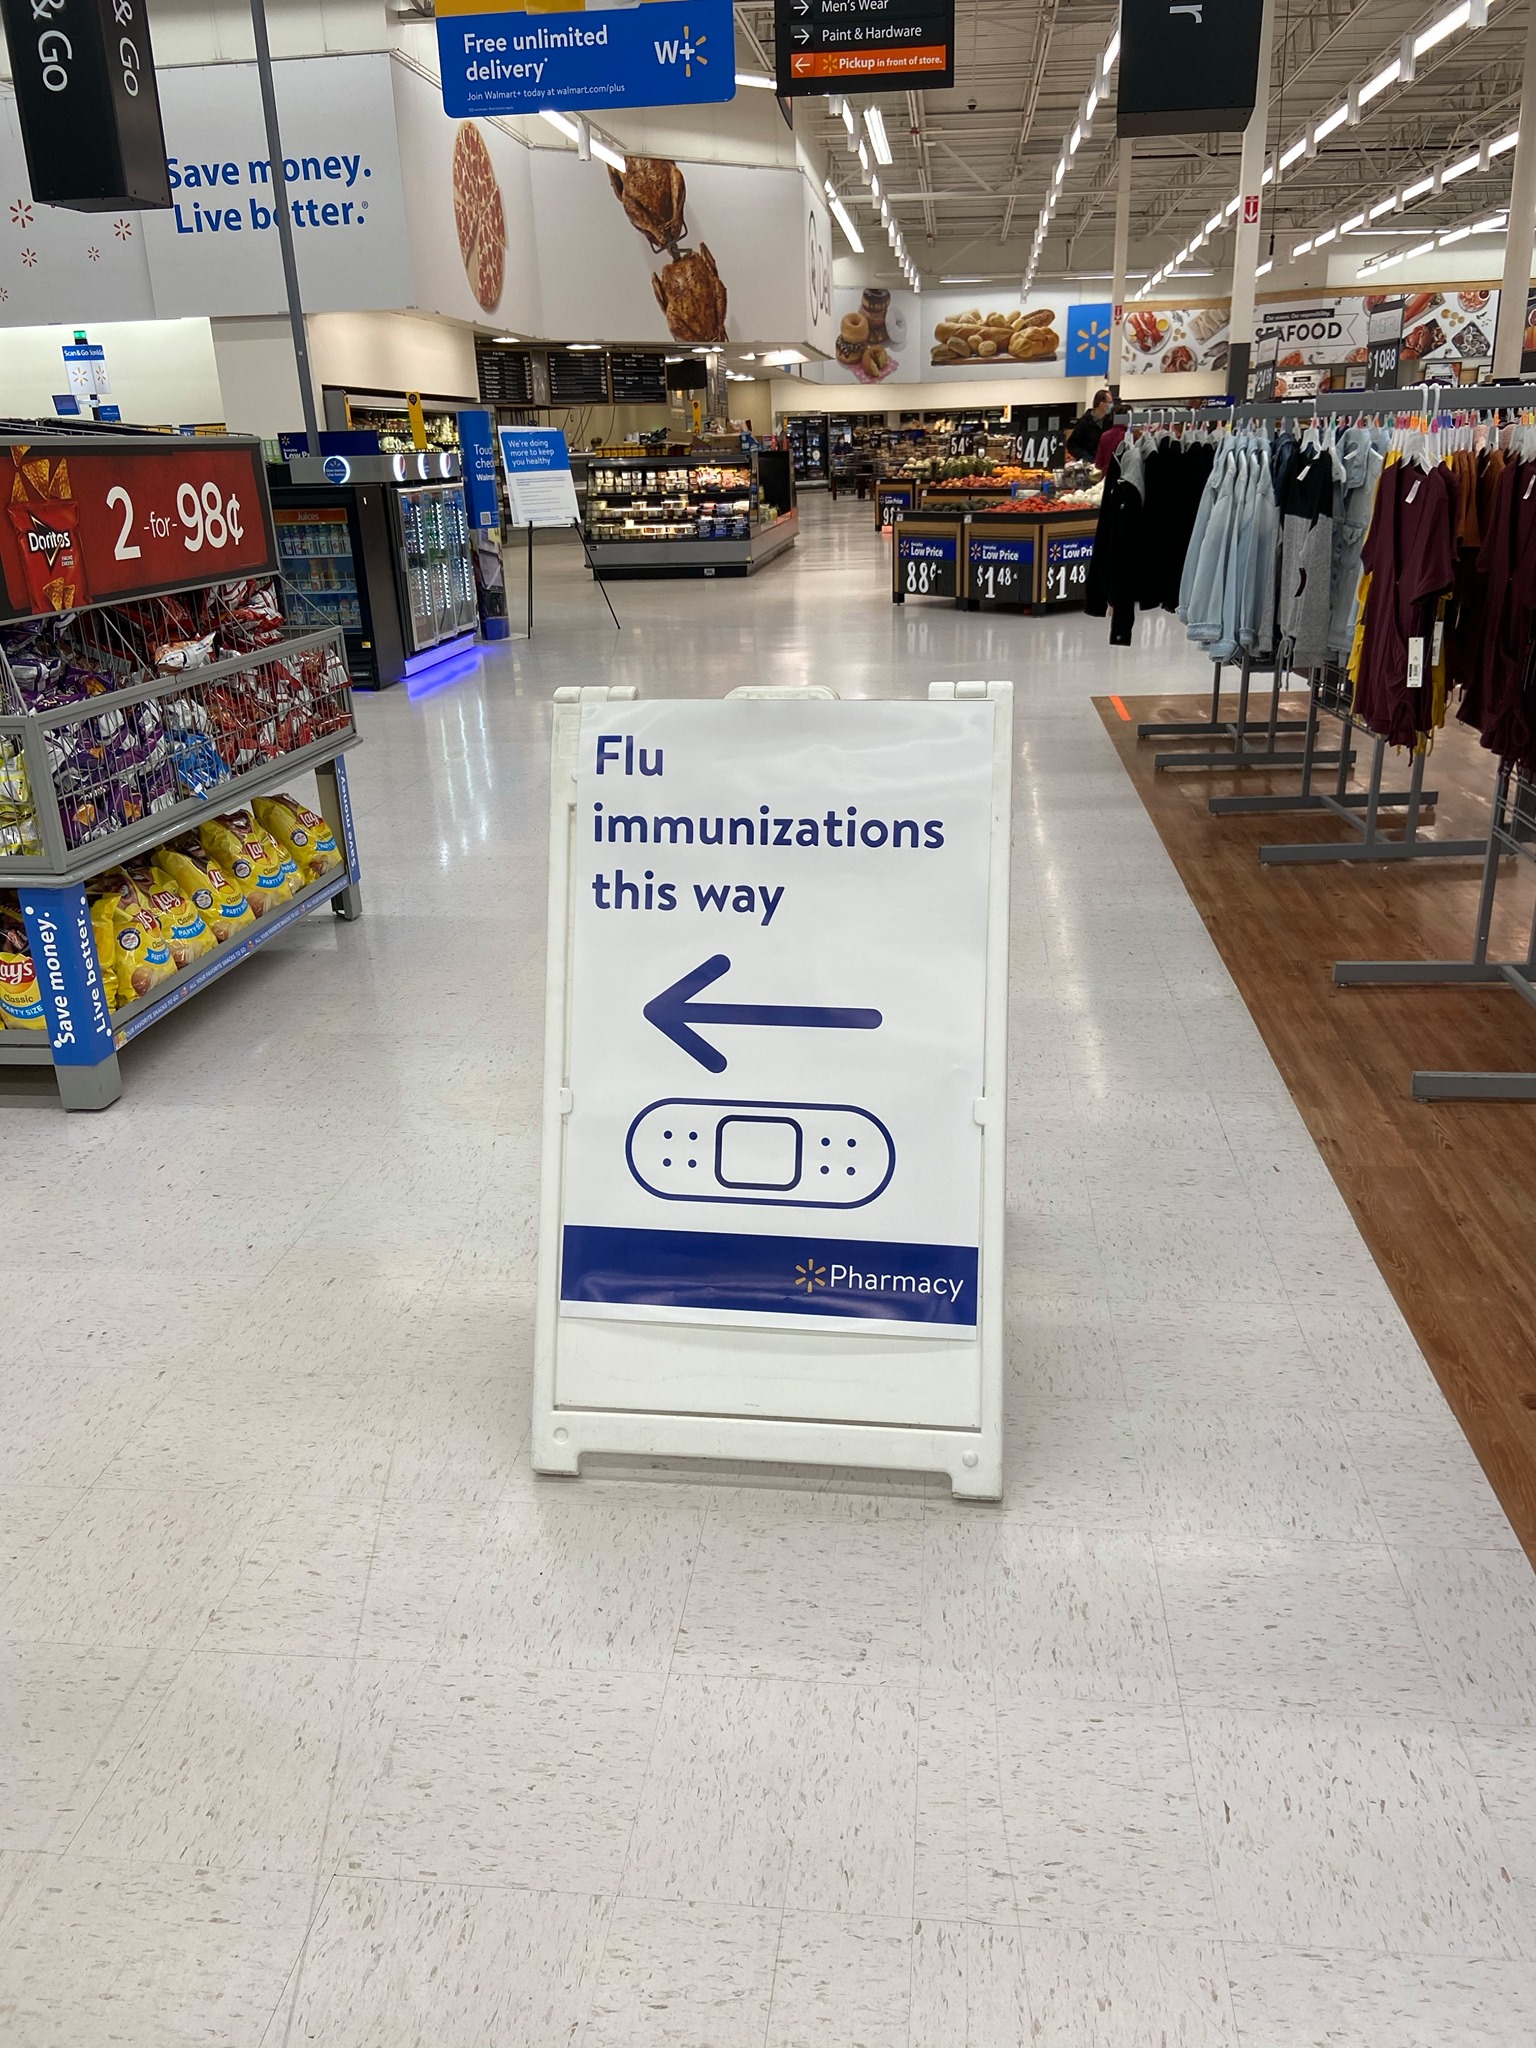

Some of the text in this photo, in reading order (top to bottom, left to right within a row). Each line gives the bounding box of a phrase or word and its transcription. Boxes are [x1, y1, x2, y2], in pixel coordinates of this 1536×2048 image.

[821, 0, 889, 13] Men's Wear
[463, 24, 609, 54] Free unlimited
[822, 25, 923, 42] Paint & Hardware
[38, 30, 72, 92] Go
[119, 37, 140, 97] Go
[838, 56, 943, 70] Pickup in front of store.
[467, 83, 625, 102] Join Walmart+ today at walmart.com/plus
[167, 154, 372, 189] Save money.
[173, 202, 242, 234] Live
[508, 440, 549, 449] We're doing
[529, 448, 538, 456] to
[539, 448, 555, 457] keep
[526, 457, 551, 466] healthy
[106, 486, 142, 561] 2
[176, 481, 244, 552] 98¢
[297, 512, 320, 520] Juices
[28, 531, 71, 552] Doritos
[911, 546, 943, 557] Low Price
[982, 549, 1019, 561] Low Price
[1063, 546, 1093, 559] Low Pri
[595, 734, 664, 777] Flu
[299, 811, 320, 828] Lay
[592, 802, 946, 850] immunizations
[152, 891, 181, 912] Lay
[592, 869, 785, 927] this way
[38, 911, 75, 1044] Save money.
[77, 909, 106, 1033] Live better.
[3, 994, 34, 1003] Classic
[25, 1004, 44, 1016] SIZE
[829, 1264, 965, 1303] Pharmacy
